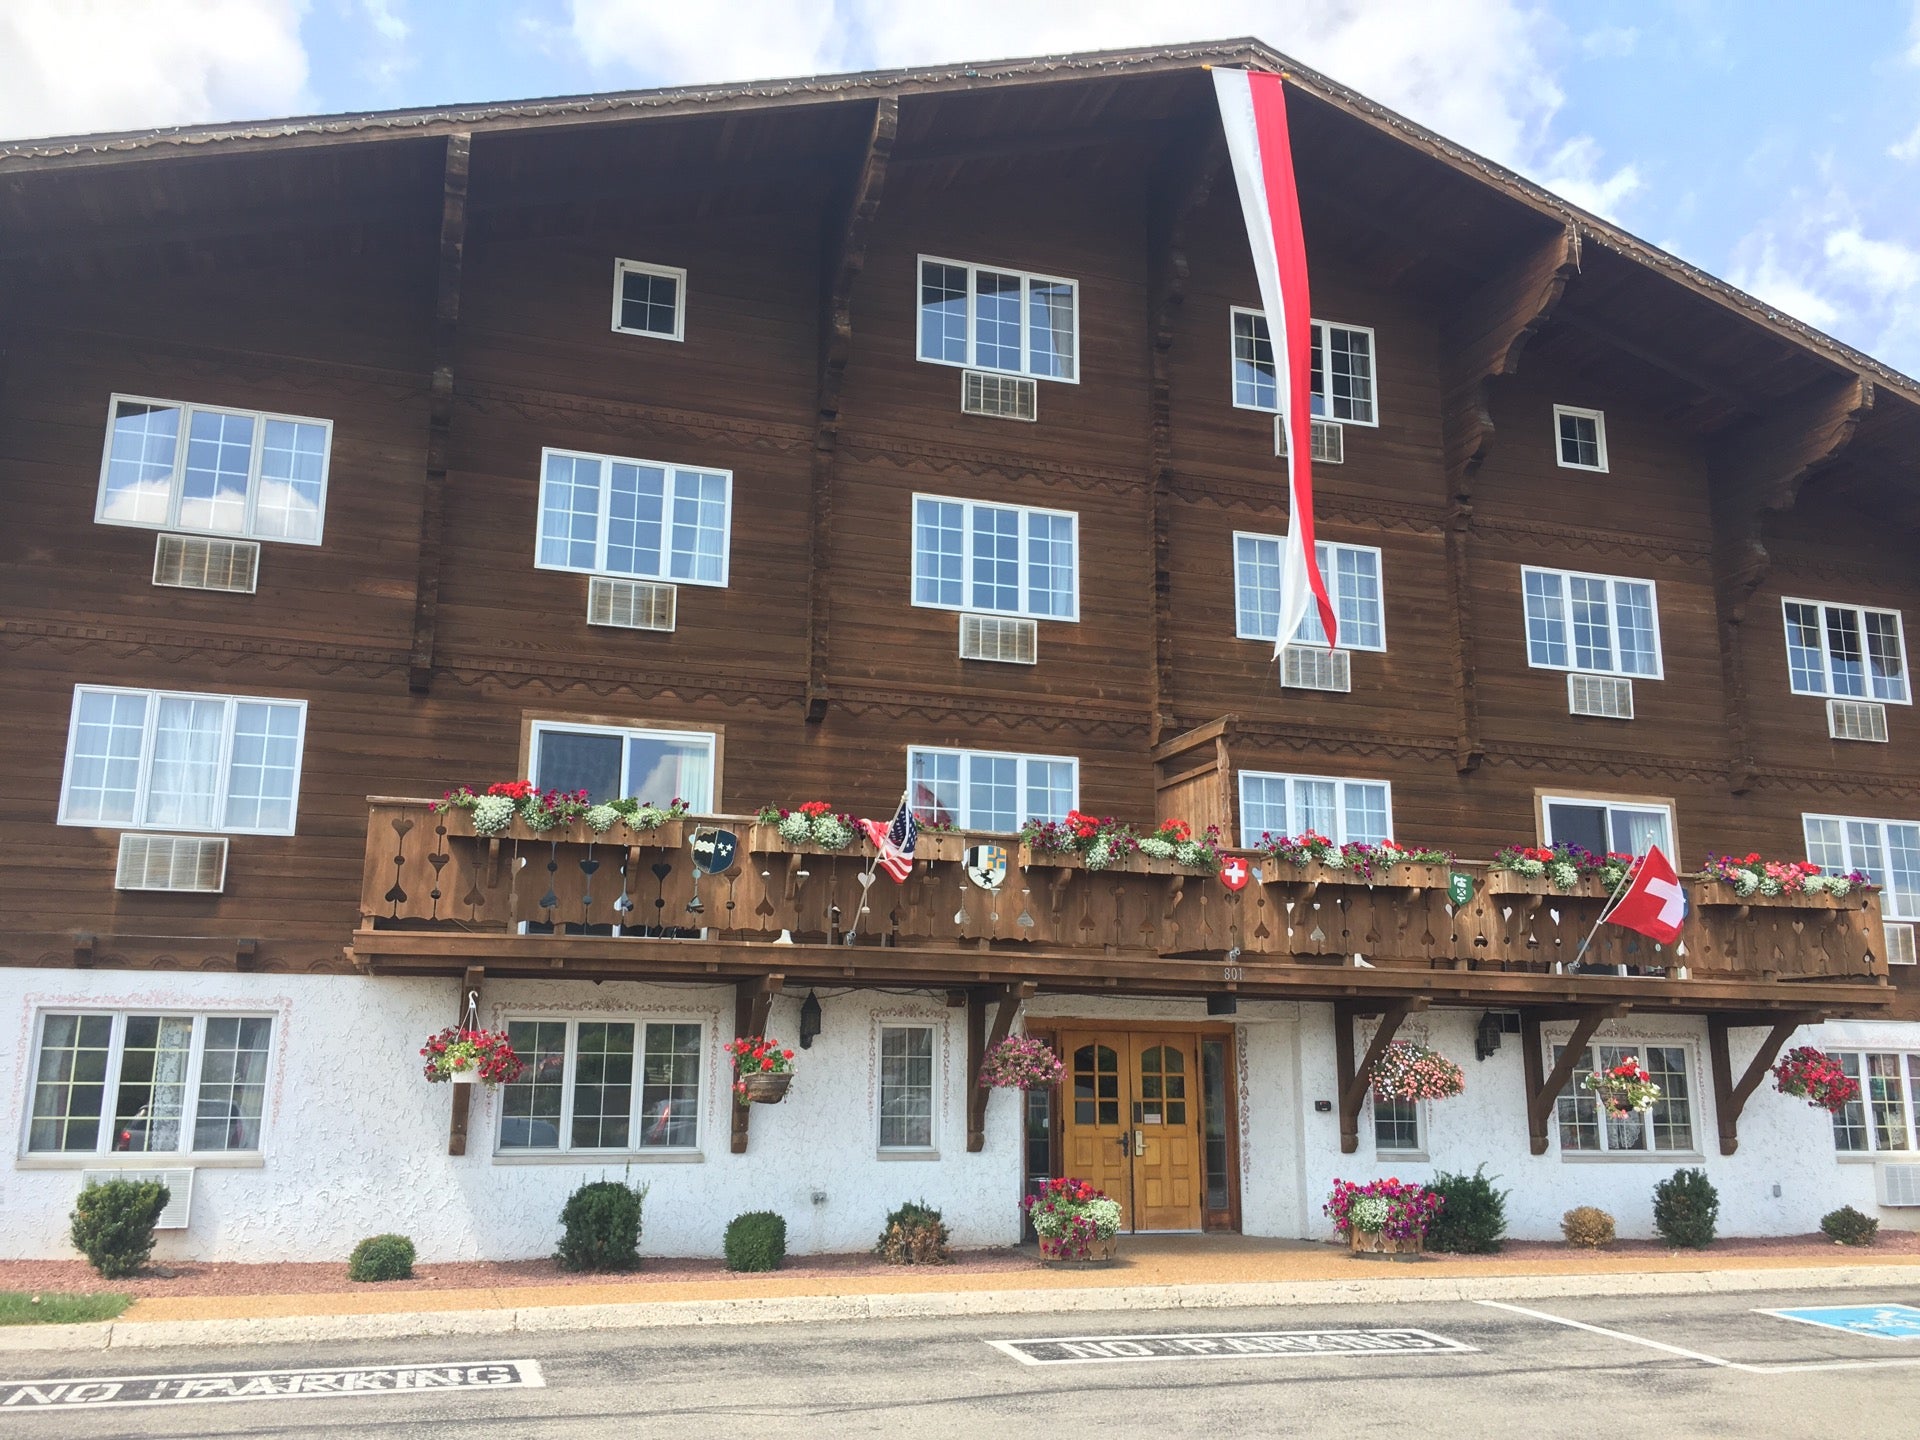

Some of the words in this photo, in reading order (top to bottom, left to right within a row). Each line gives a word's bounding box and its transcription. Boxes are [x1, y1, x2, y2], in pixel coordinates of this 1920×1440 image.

[1224, 967, 1243, 980] 801
[1057, 1341, 1154, 1357] NO
[3, 1383, 123, 1405] NO
